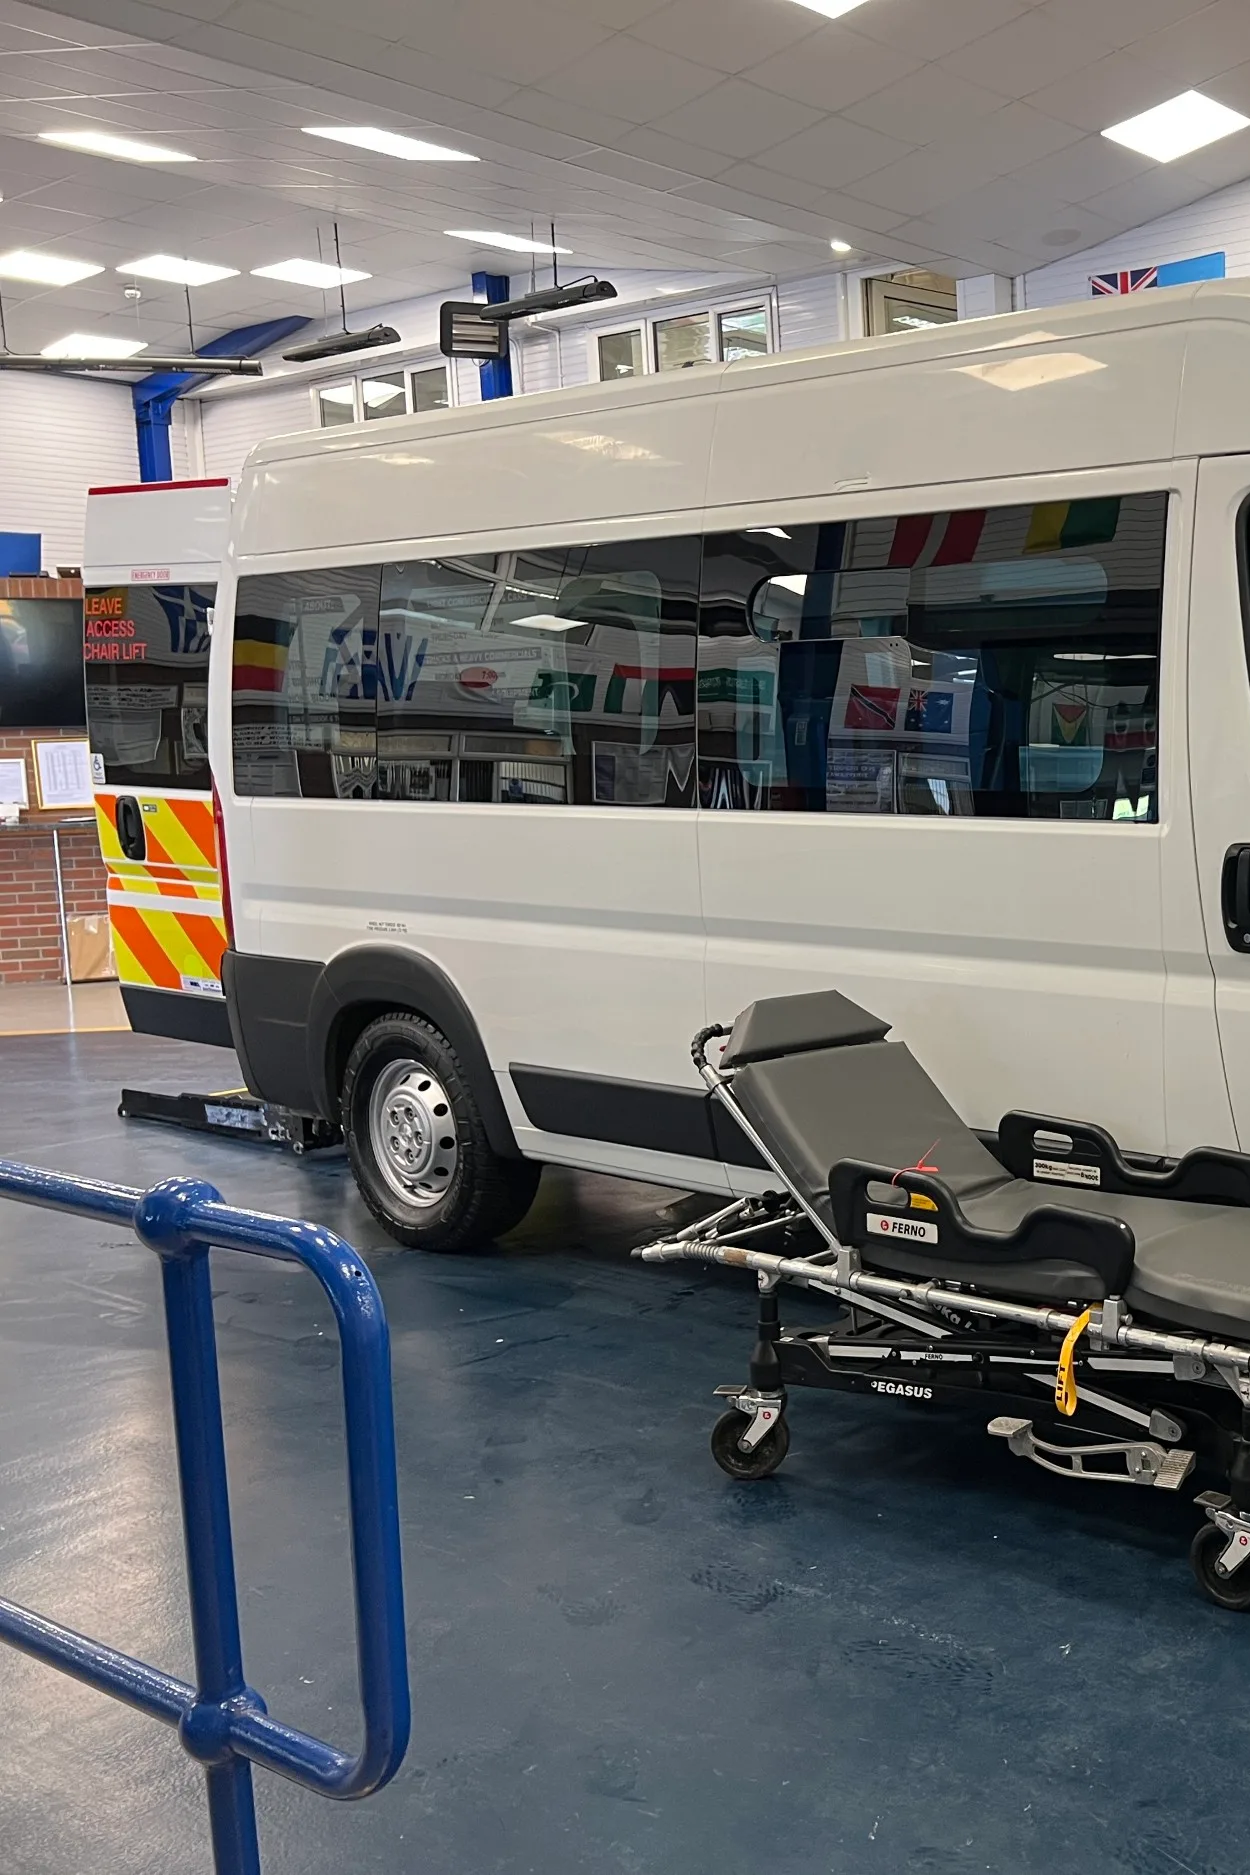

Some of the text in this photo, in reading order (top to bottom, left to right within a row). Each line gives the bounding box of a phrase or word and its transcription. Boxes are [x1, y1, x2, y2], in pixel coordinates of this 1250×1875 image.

[84, 598, 122, 615] LEAVE
[86, 620, 135, 638] ACCESS
[83, 643, 147, 660] CHAIR LIFT
[892, 1222, 926, 1238] FERNO
